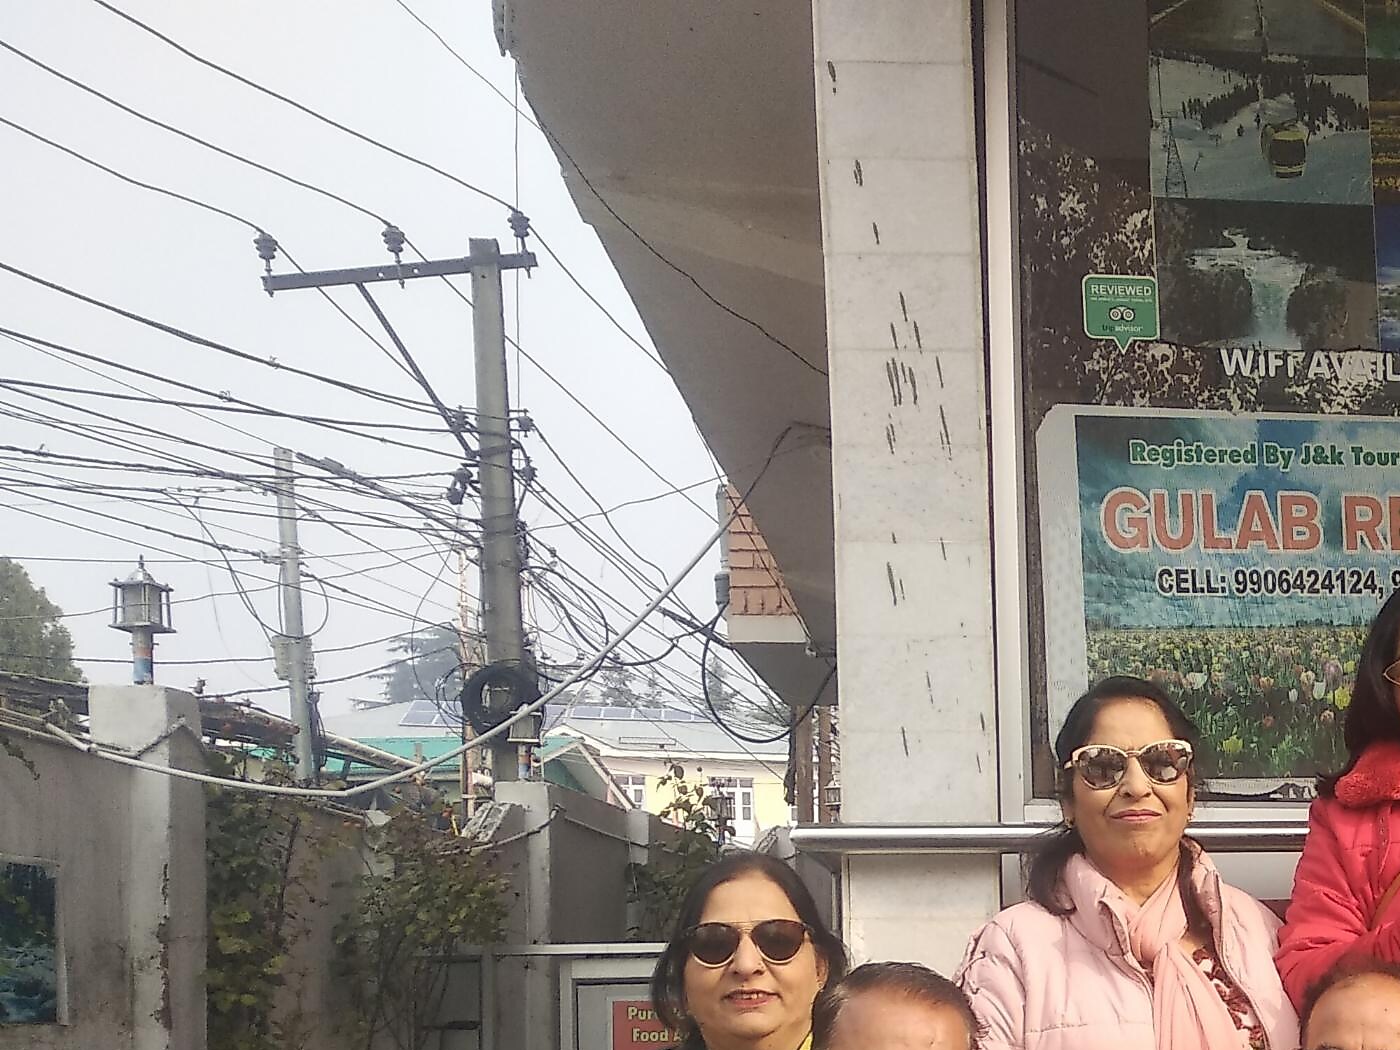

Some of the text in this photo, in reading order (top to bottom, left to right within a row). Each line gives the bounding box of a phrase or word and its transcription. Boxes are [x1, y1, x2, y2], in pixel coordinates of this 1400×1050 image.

[1091, 285, 1152, 296] REVIEWED
[1129, 440, 1258, 469] Registered
[1263, 443, 1295, 471] By
[1301, 444, 1346, 466] J&k
[1103, 489, 1323, 551] GULAB
[1157, 567, 1229, 595] CELL:
[1233, 568, 1384, 600] 9906424124,
[633, 1028, 669, 1042] Food
